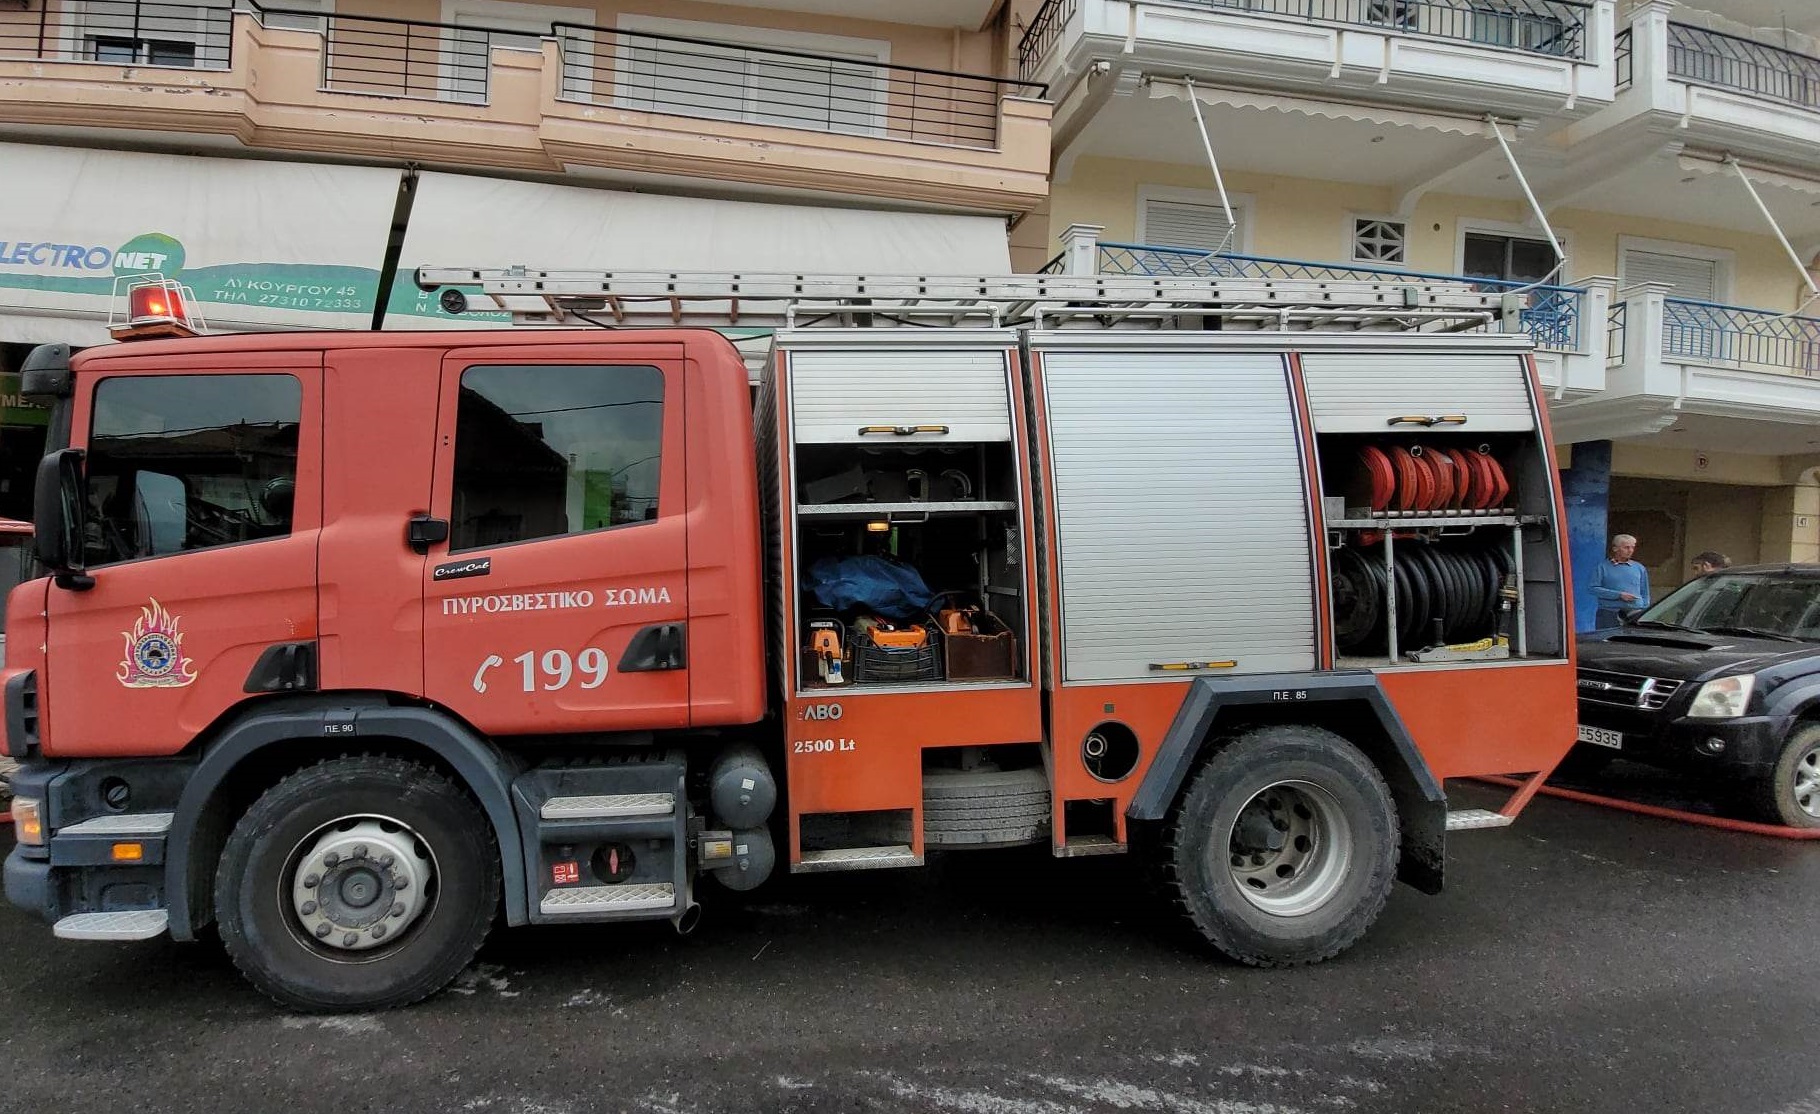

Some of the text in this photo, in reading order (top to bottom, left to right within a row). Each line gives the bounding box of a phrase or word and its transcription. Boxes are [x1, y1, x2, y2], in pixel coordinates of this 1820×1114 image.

[114, 252, 167, 269] NET
[336, 286, 356, 296] 45
[435, 561, 490, 576] CrewCab
[442, 586, 672, 615] ΠΥΡΟΣΒΕΣΤΙΚΟ ΣΩΜΑ
[514, 647, 609, 692] 199
[1295, 690, 1307, 700] 85
[797, 703, 843, 720] ΛΒΟ
[342, 724, 354, 732] 90
[794, 738, 856, 753] 2500 Lt
